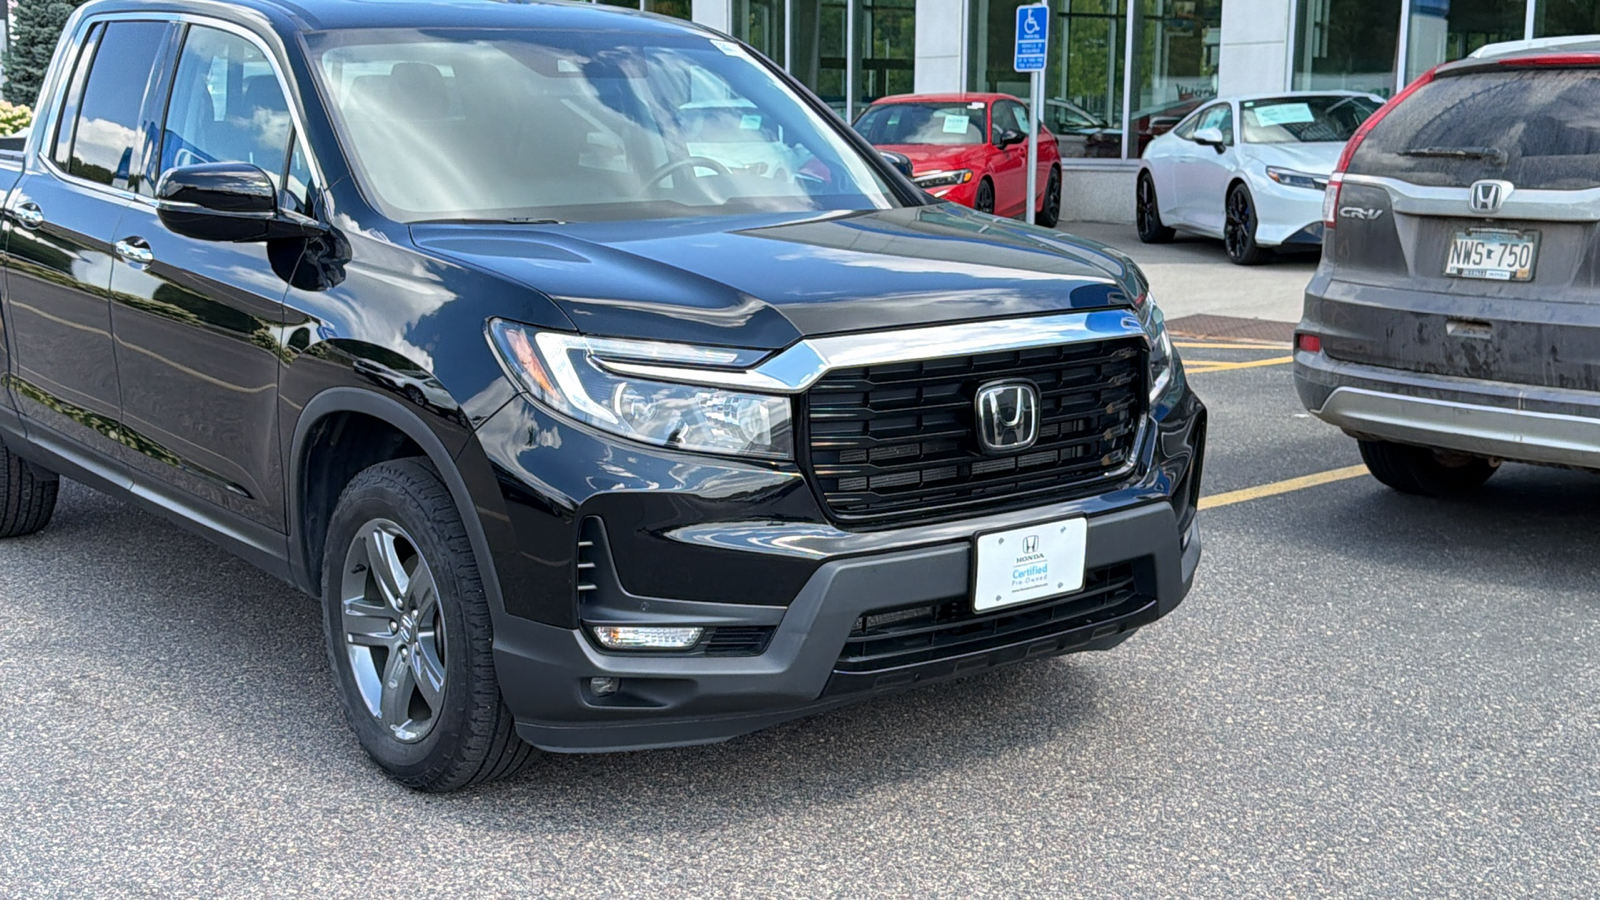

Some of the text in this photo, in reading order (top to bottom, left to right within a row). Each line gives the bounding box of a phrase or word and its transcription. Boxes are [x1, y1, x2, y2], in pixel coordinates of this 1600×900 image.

[1339, 206, 1384, 220] CR-V
[1450, 241, 1531, 269] NWS 750
[1016, 552, 1045, 564] HONDA
[1012, 563, 1048, 579] Certified
